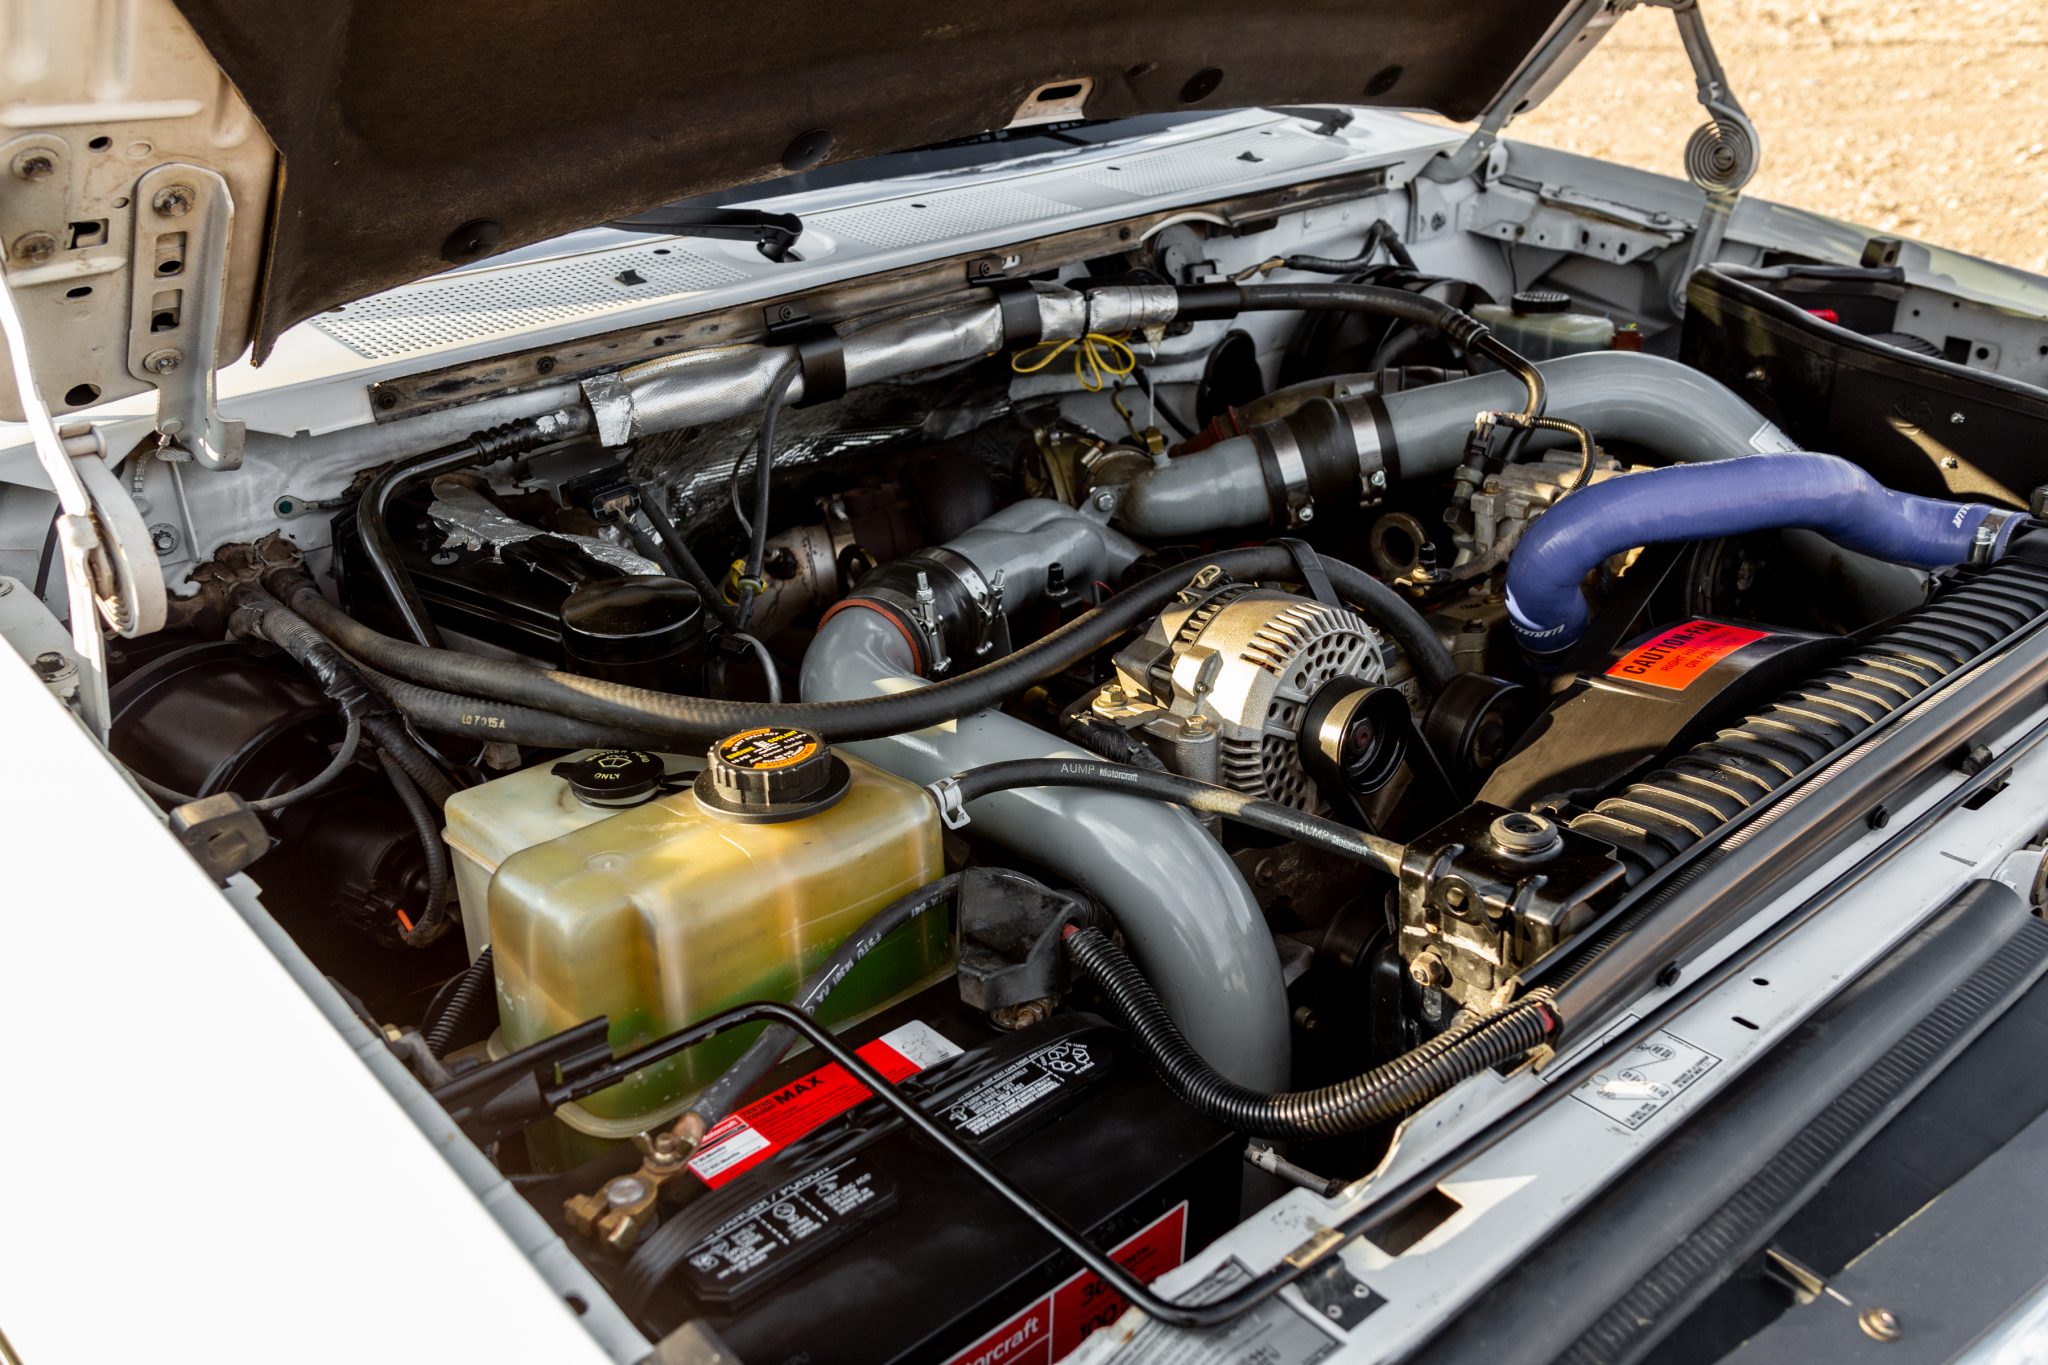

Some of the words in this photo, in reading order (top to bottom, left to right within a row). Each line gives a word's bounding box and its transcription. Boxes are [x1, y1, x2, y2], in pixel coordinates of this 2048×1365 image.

[1622, 623, 1720, 675] CAUTION-FAN
[1660, 654, 1686, 672] RIGHT
[726, 746, 756, 759] ENGINE
[767, 730, 798, 743] COOLANT
[593, 772, 621, 780] ONLY
[1060, 763, 1096, 775] AUMP
[1098, 768, 1139, 783] Motorcraft
[773, 1074, 824, 1106] MAX
